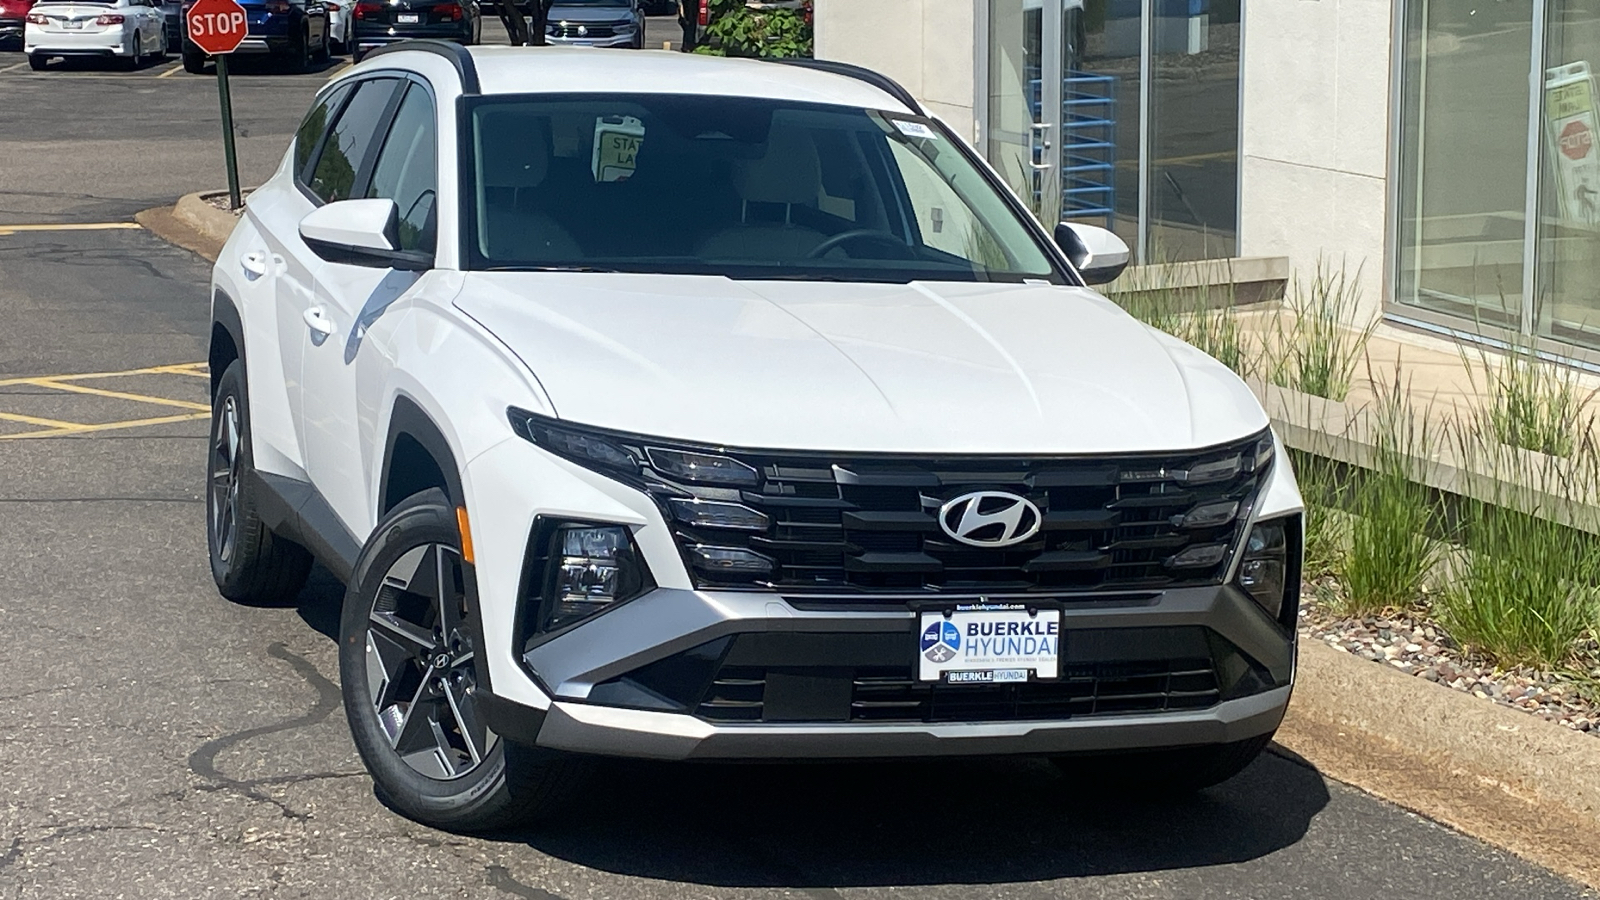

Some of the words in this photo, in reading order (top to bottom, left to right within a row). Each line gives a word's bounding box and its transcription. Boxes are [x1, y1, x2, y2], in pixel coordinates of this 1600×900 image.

[192, 12, 243, 36] STOP
[956, 603, 1025, 611] buerklehyundai.com
[966, 621, 1058, 637] BUERKLE
[965, 637, 1058, 656] HYUNDAI
[949, 671, 993, 681] BUERKLE
[994, 670, 1026, 680] HYUNDAI
